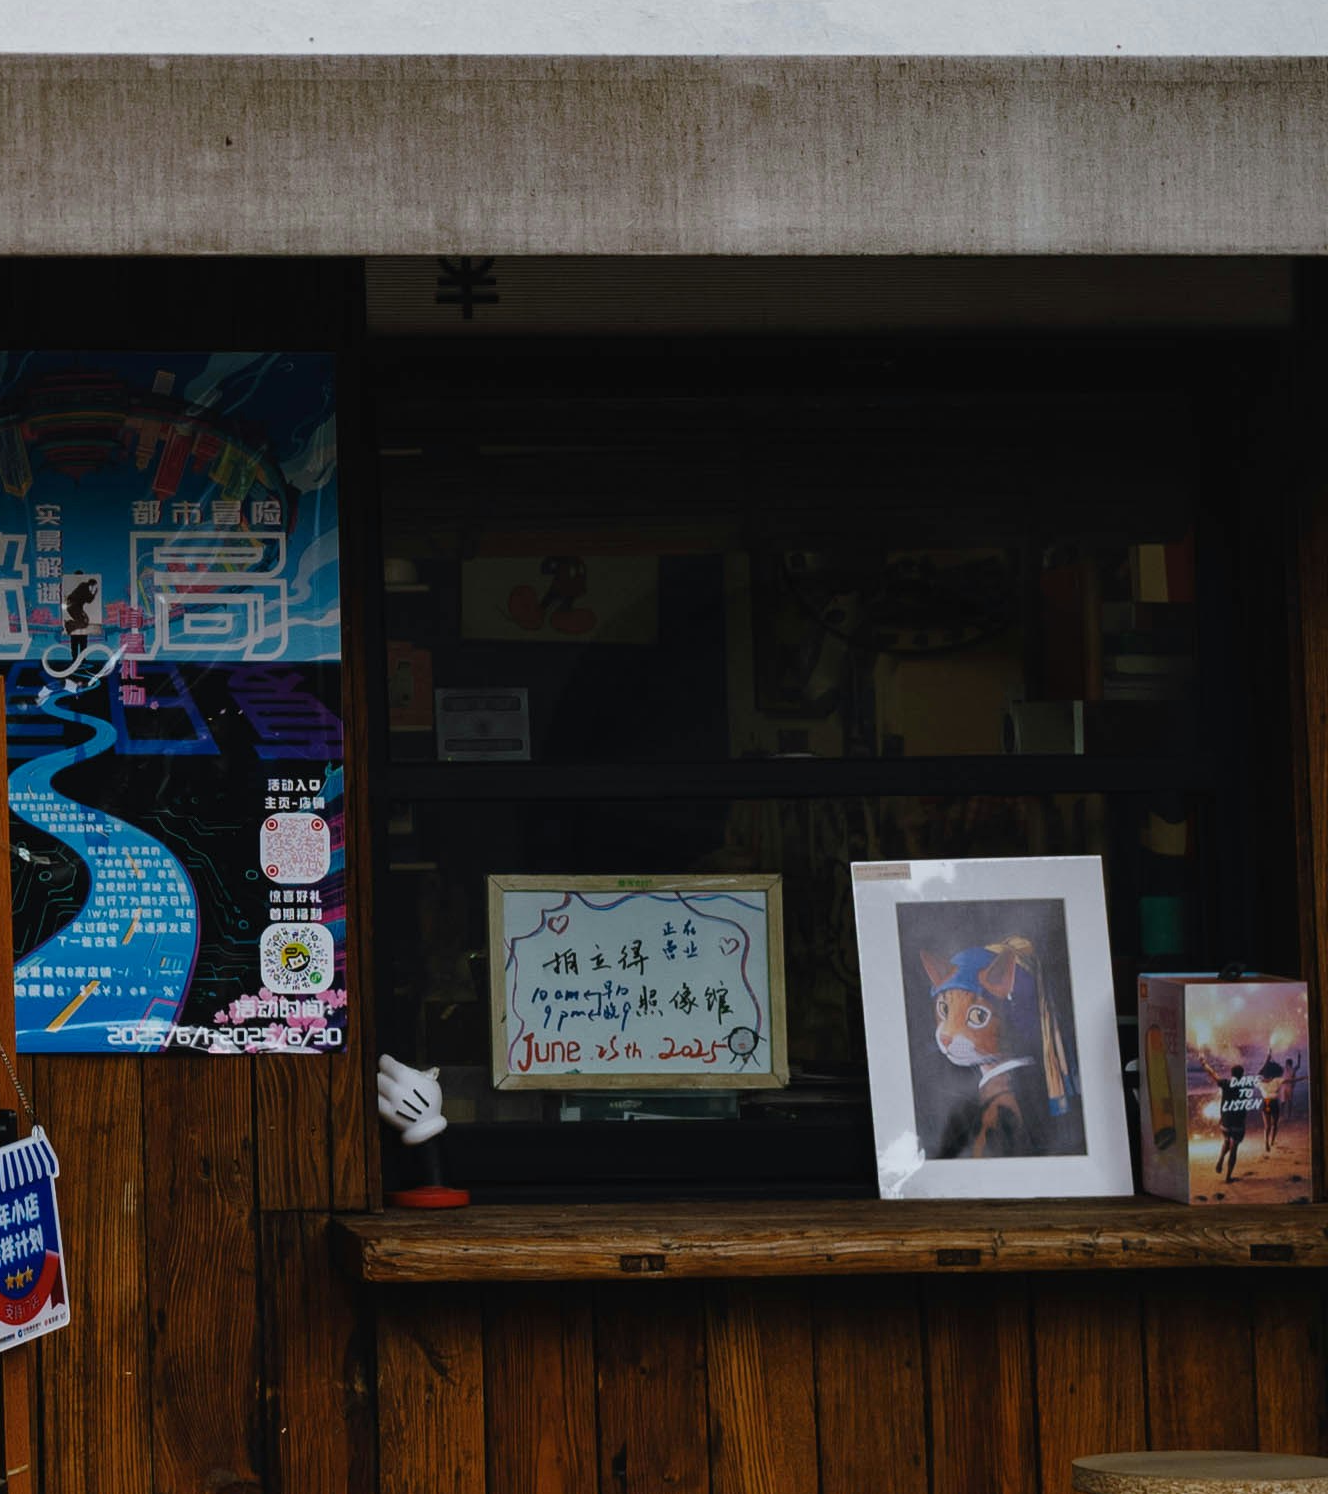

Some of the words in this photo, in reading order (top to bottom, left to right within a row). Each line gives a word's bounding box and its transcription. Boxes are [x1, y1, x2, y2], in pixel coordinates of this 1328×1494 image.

[131, 499, 283, 526] 都市冒险
[34, 502, 63, 605] 实景解谜
[267, 778, 321, 792] 活动入口
[264, 796, 325, 810] 主页-店铺
[269, 889, 322, 903] 惊喜好礼
[663, 919, 697, 936] 正在
[542, 939, 649, 976] 拍立得
[662, 940, 699, 961] 营业
[1228, 1076, 1262, 1088] DARE
[1238, 1087, 1254, 1099] TO
[1221, 1098, 1263, 1112] LISTEN
